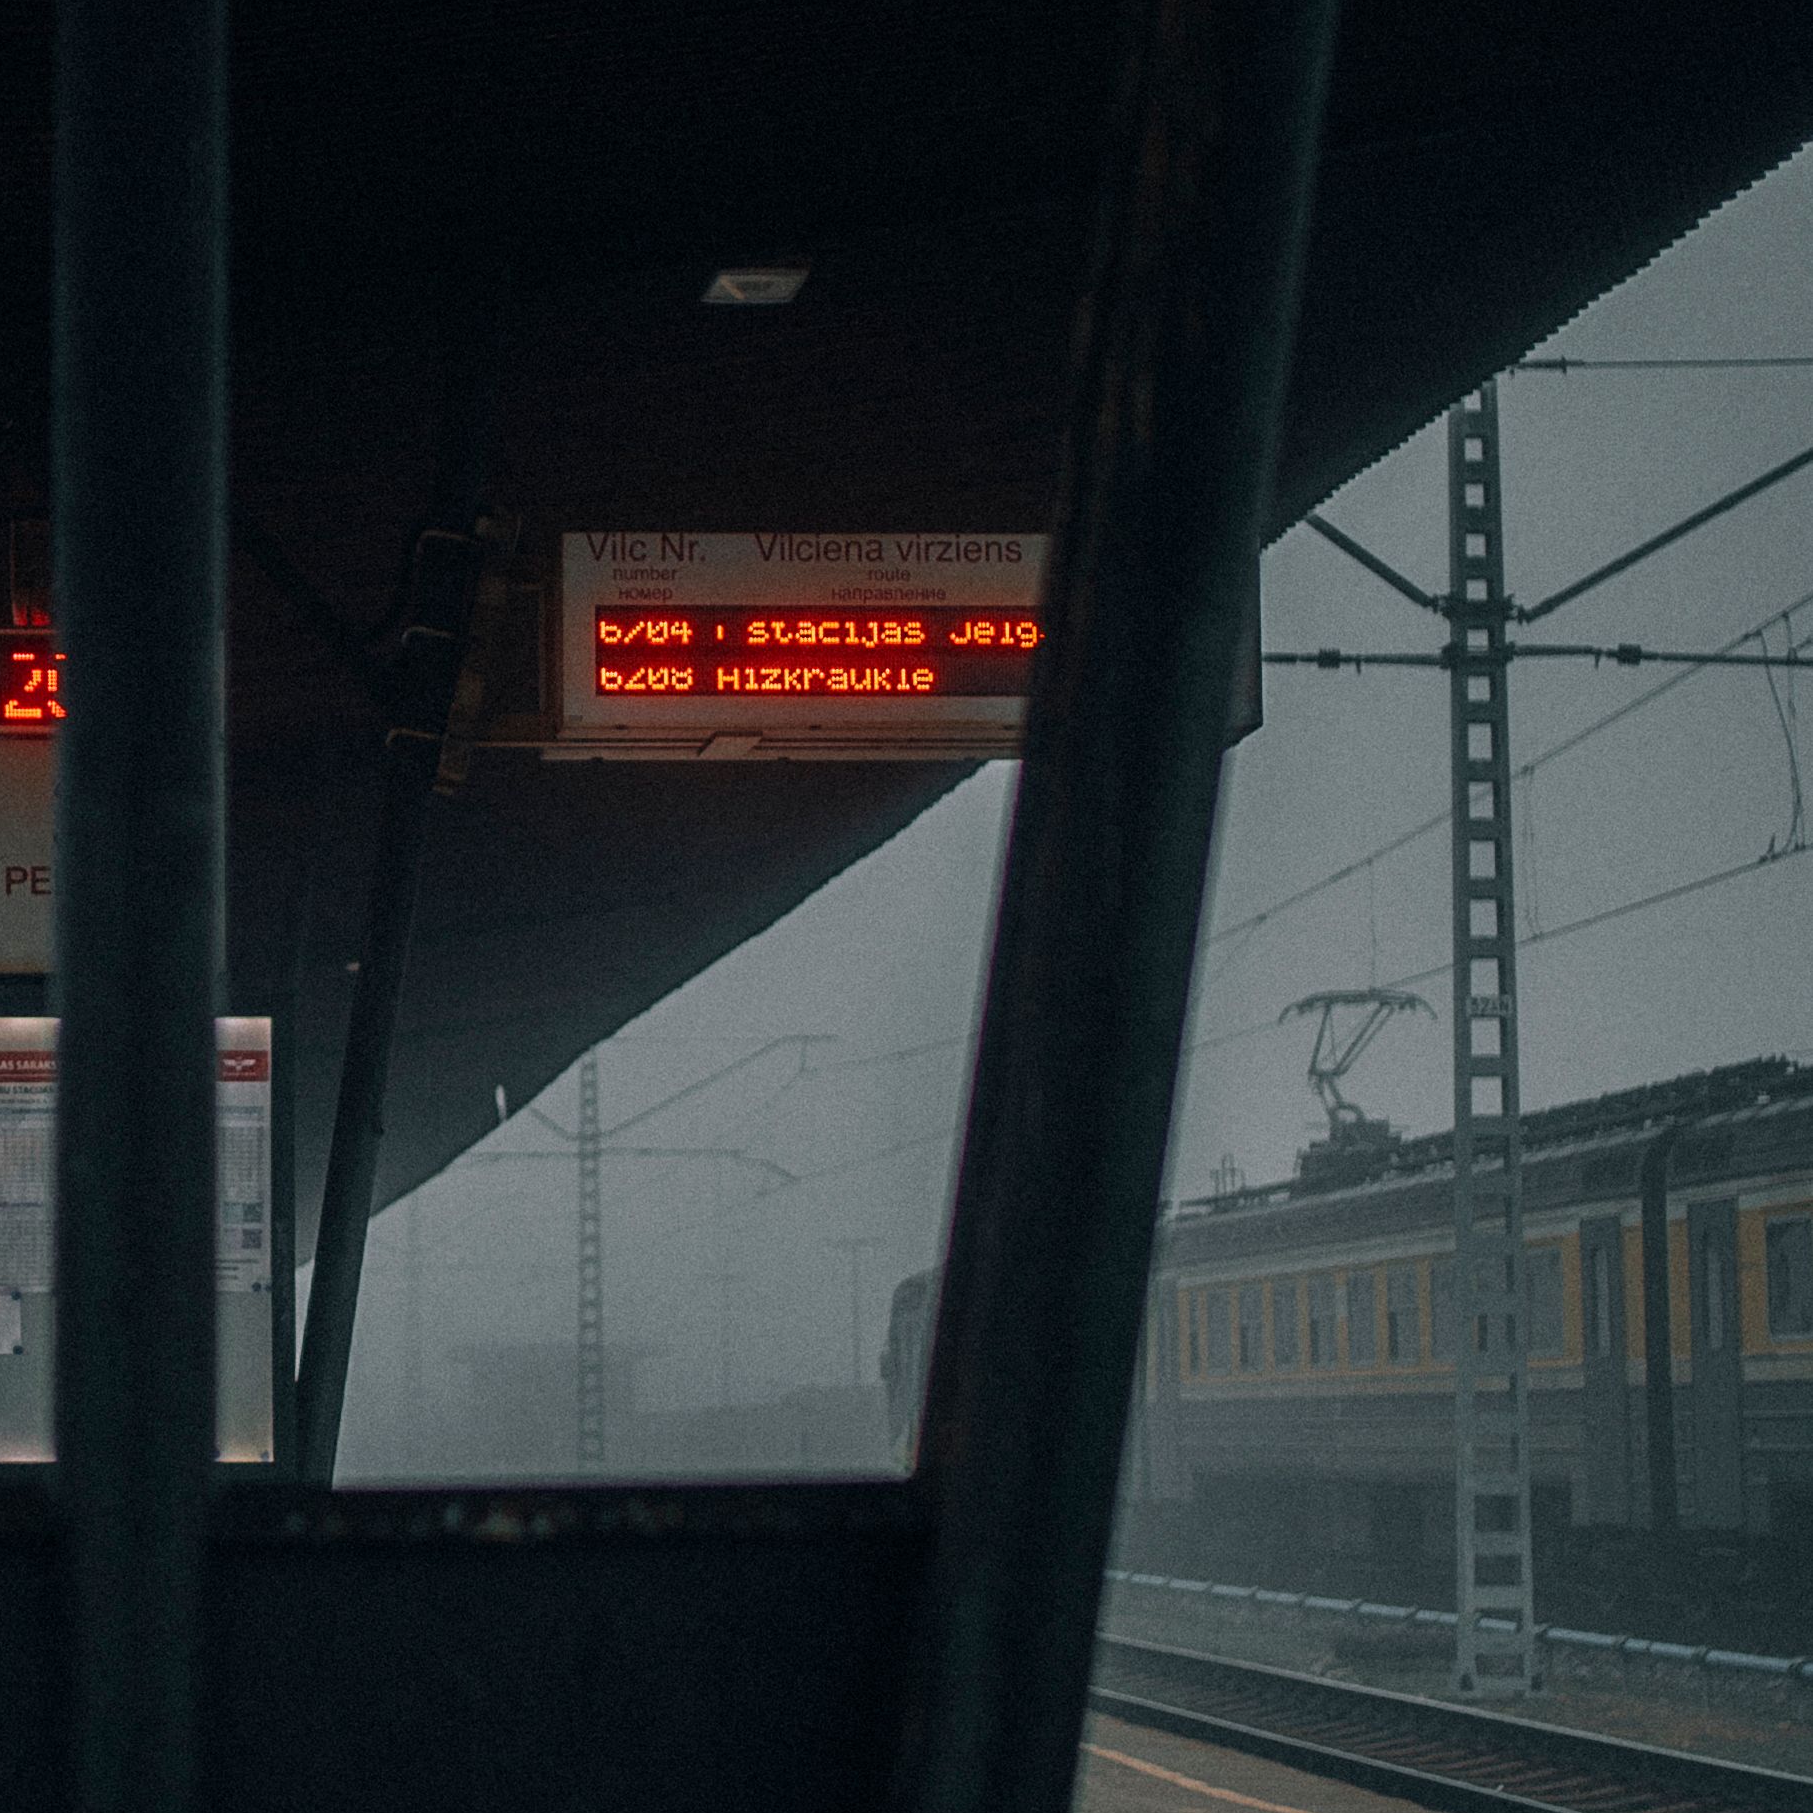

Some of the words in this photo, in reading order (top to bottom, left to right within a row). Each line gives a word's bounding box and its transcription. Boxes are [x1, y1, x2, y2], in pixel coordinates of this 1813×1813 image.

[586, 533, 647, 562] Vilc
[661, 533, 707, 562] Nr.
[755, 533, 883, 562] Vilciena
[896, 533, 1023, 562] virziens
[612, 567, 677, 582] number
[867, 567, 911, 582] route
[618, 587, 674, 603] номер
[831, 586, 947, 603] направление
[950, 620, 1045, 648] Jelg
